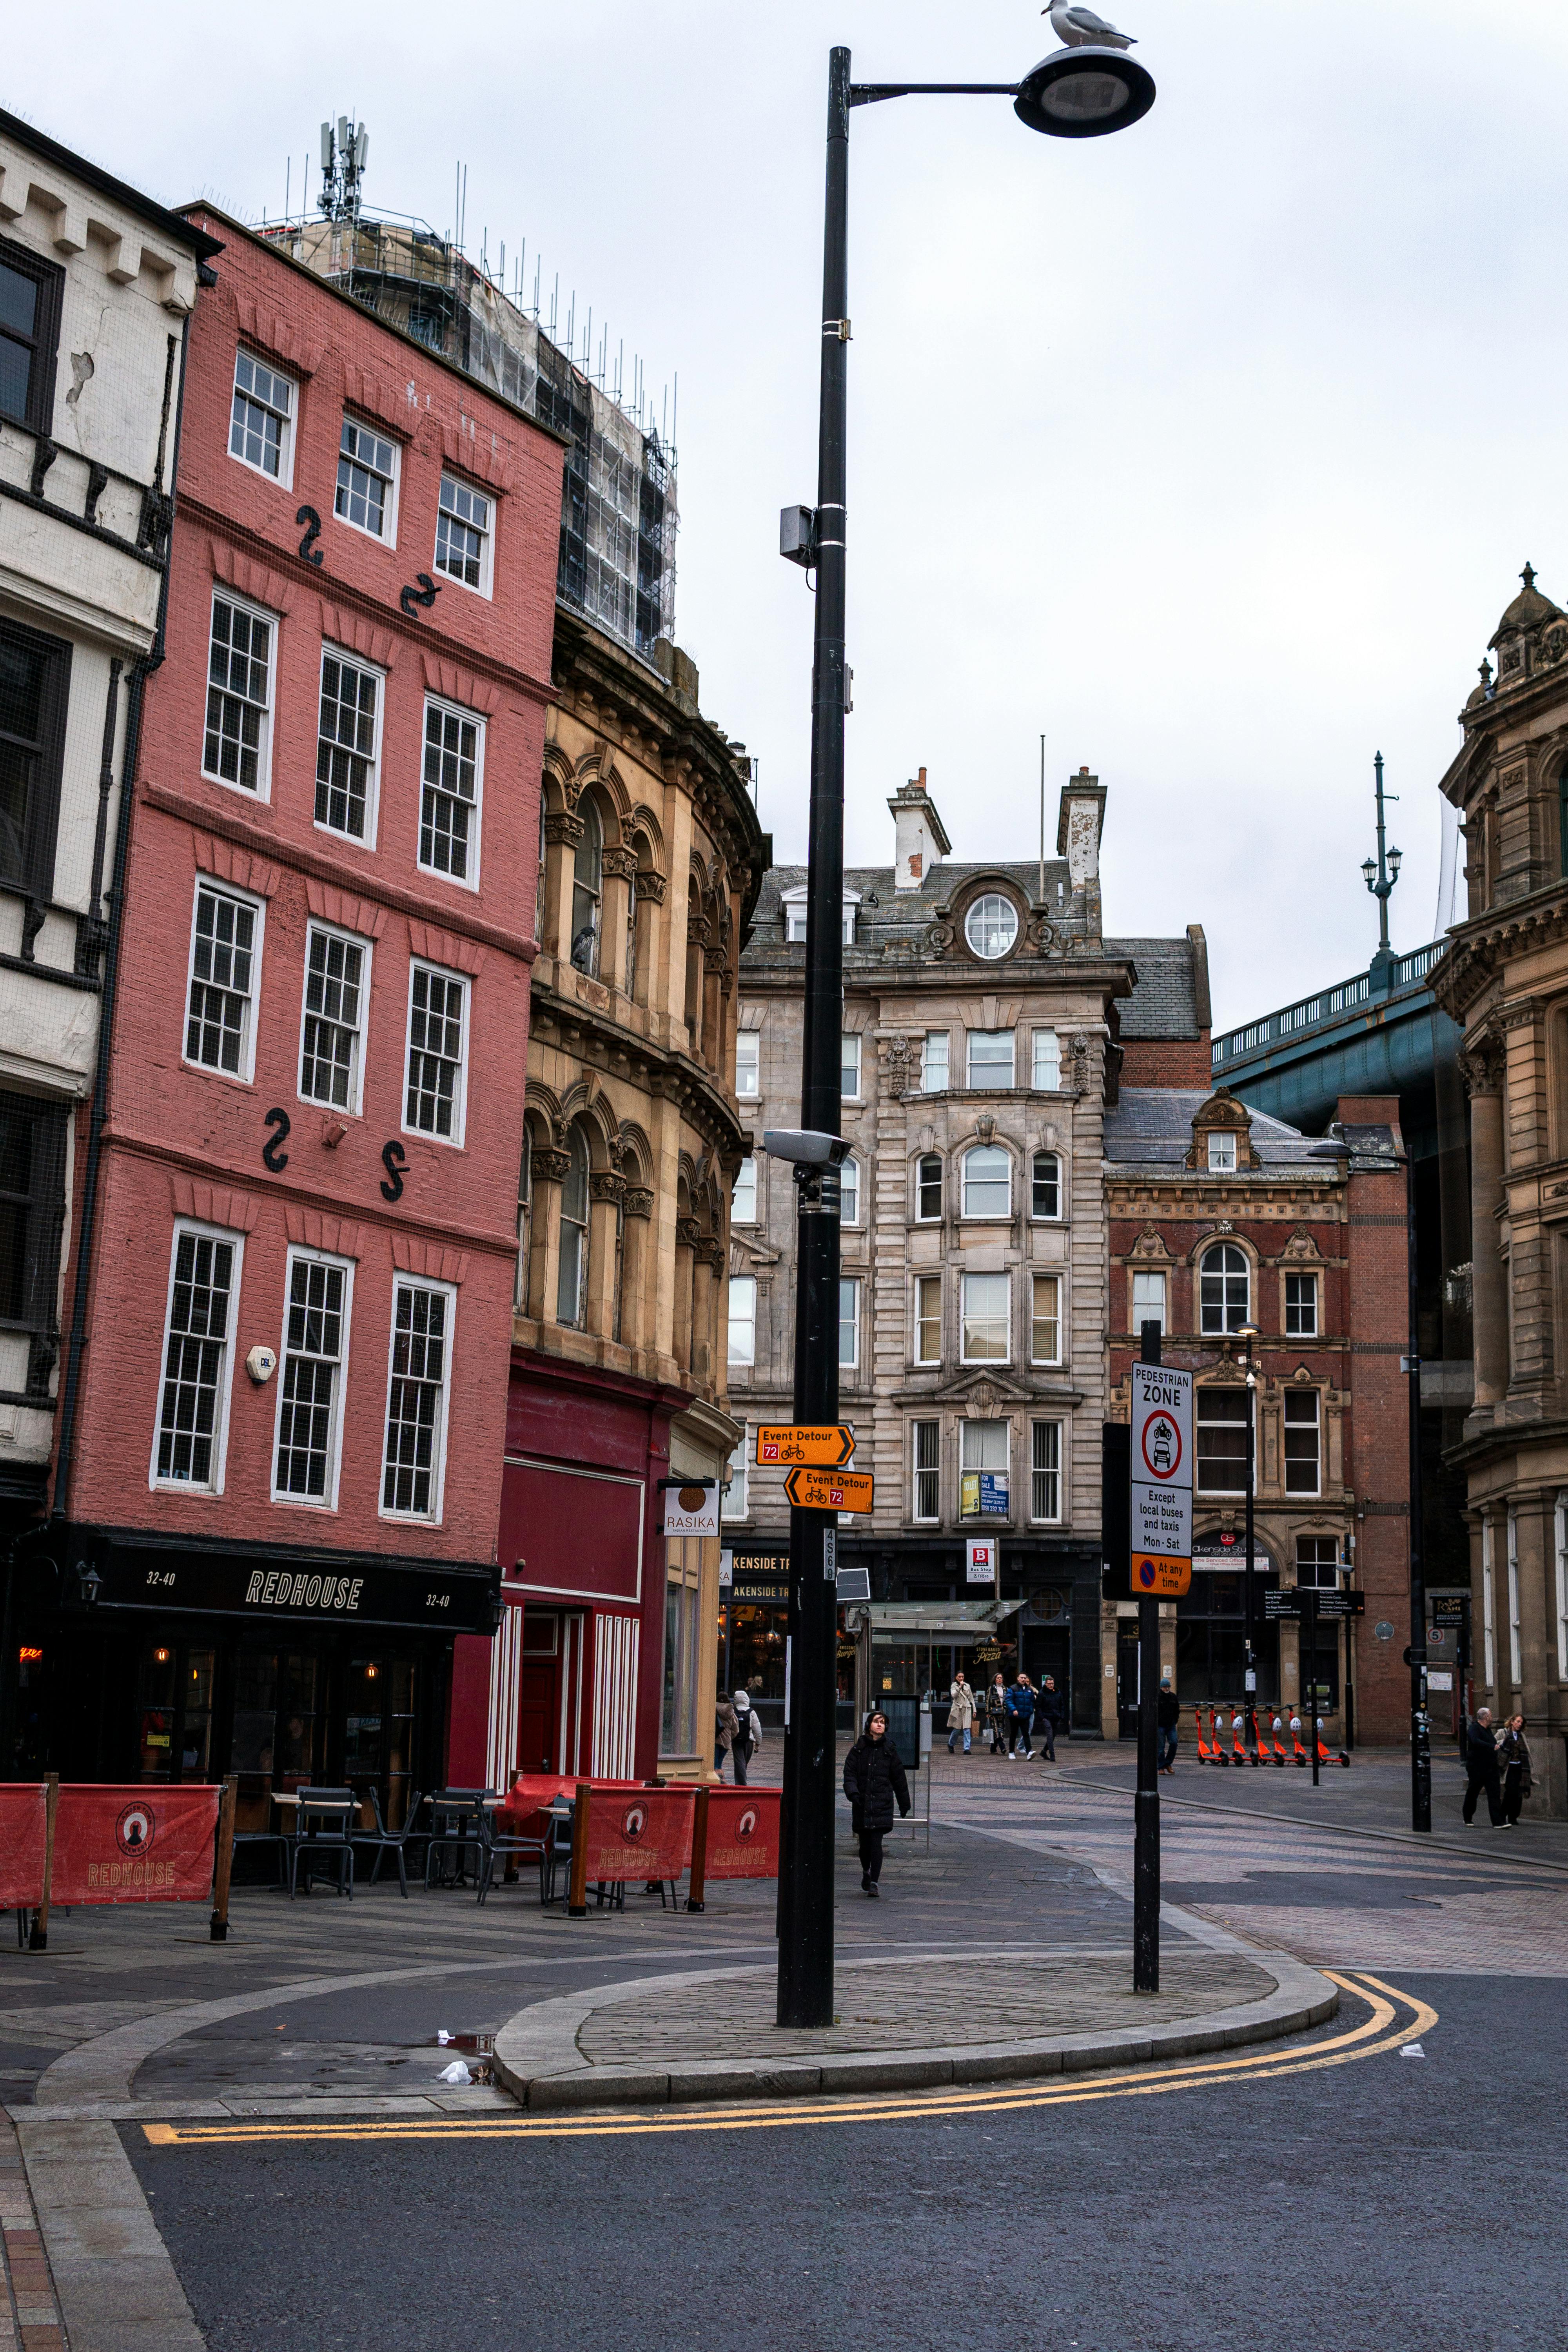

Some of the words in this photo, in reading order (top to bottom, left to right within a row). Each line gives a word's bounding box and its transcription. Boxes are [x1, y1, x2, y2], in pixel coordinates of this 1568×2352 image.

[1136, 1368, 1189, 1388] PEDESTRIAN
[1143, 1384, 1181, 1406] ZONE
[763, 1431, 793, 1441] Event
[797, 1431, 832, 1441] Detour
[765, 1446, 777, 1456] 72
[807, 1474, 833, 1485] Event
[837, 1477, 869, 1489] Detour
[831, 1492, 842, 1502] 72
[1149, 1490, 1176, 1504] Except
[1140, 1503, 1159, 1515] local
[1161, 1506, 1183, 1518] buses
[667, 1517, 715, 1528] RASIKA
[1144, 1519, 1158, 1529] and
[1161, 1521, 1180, 1531] taxis
[1143, 1535, 1160, 1547] Mon
[1166, 1537, 1180, 1549] Sat
[976, 1550, 985, 1560] B
[733, 1557, 776, 1569] KENSIDE
[1158, 1562, 1167, 1573] At
[1170, 1565, 1183, 1577] any
[147, 1571, 176, 1586] 32-40
[245, 1570, 364, 1609] REDHOUSE
[426, 1594, 450, 1607] 32-40
[1162, 1577, 1179, 1588] time
[734, 1587, 776, 1597] AKENSIDE
[1432, 1631, 1439, 1640] 5
[973, 1651, 1002, 1664] Pizza
[120, 1806, 141, 1825] CAMDEN
[143, 1807, 152, 1824] TOWN
[599, 1848, 660, 1867] REDHOUSE
[713, 1847, 767, 1866] REDHOUSE
[88, 1862, 175, 1887] REDHOUSE
